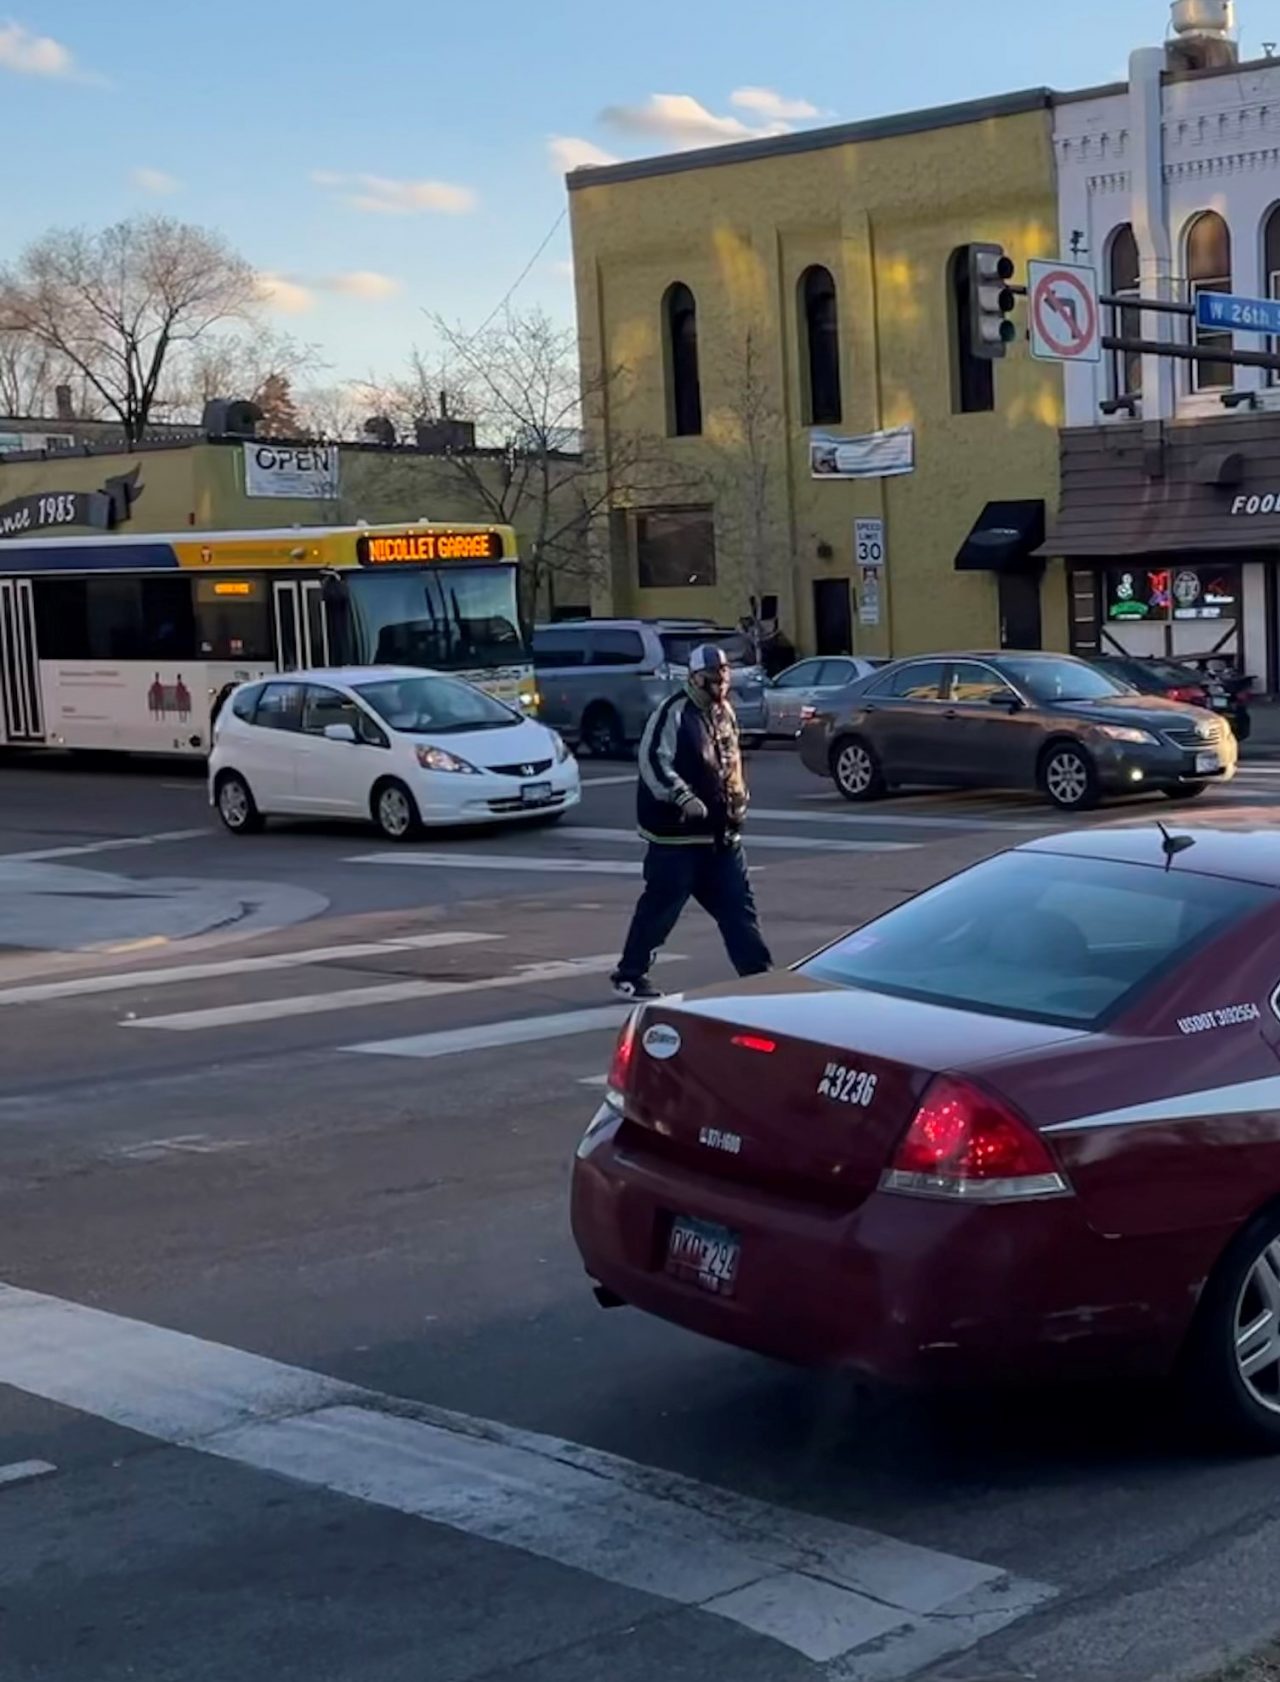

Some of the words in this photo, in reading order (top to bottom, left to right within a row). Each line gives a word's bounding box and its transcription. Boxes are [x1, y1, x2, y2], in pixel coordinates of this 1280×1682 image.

[1209, 302, 1224, 320] W
[1232, 304, 1270, 325] 26th
[256, 448, 329, 471] OPEN
[38, 494, 75, 524] 1985
[856, 522, 881, 531] SPEED
[858, 532, 879, 541] LIMIT
[368, 537, 434, 562] NICOLLET
[437, 534, 490, 558] GARAGE
[858, 543, 882, 560] 30
[1177, 1011, 1217, 1034] USDOT
[830, 1066, 878, 1107] 3236
